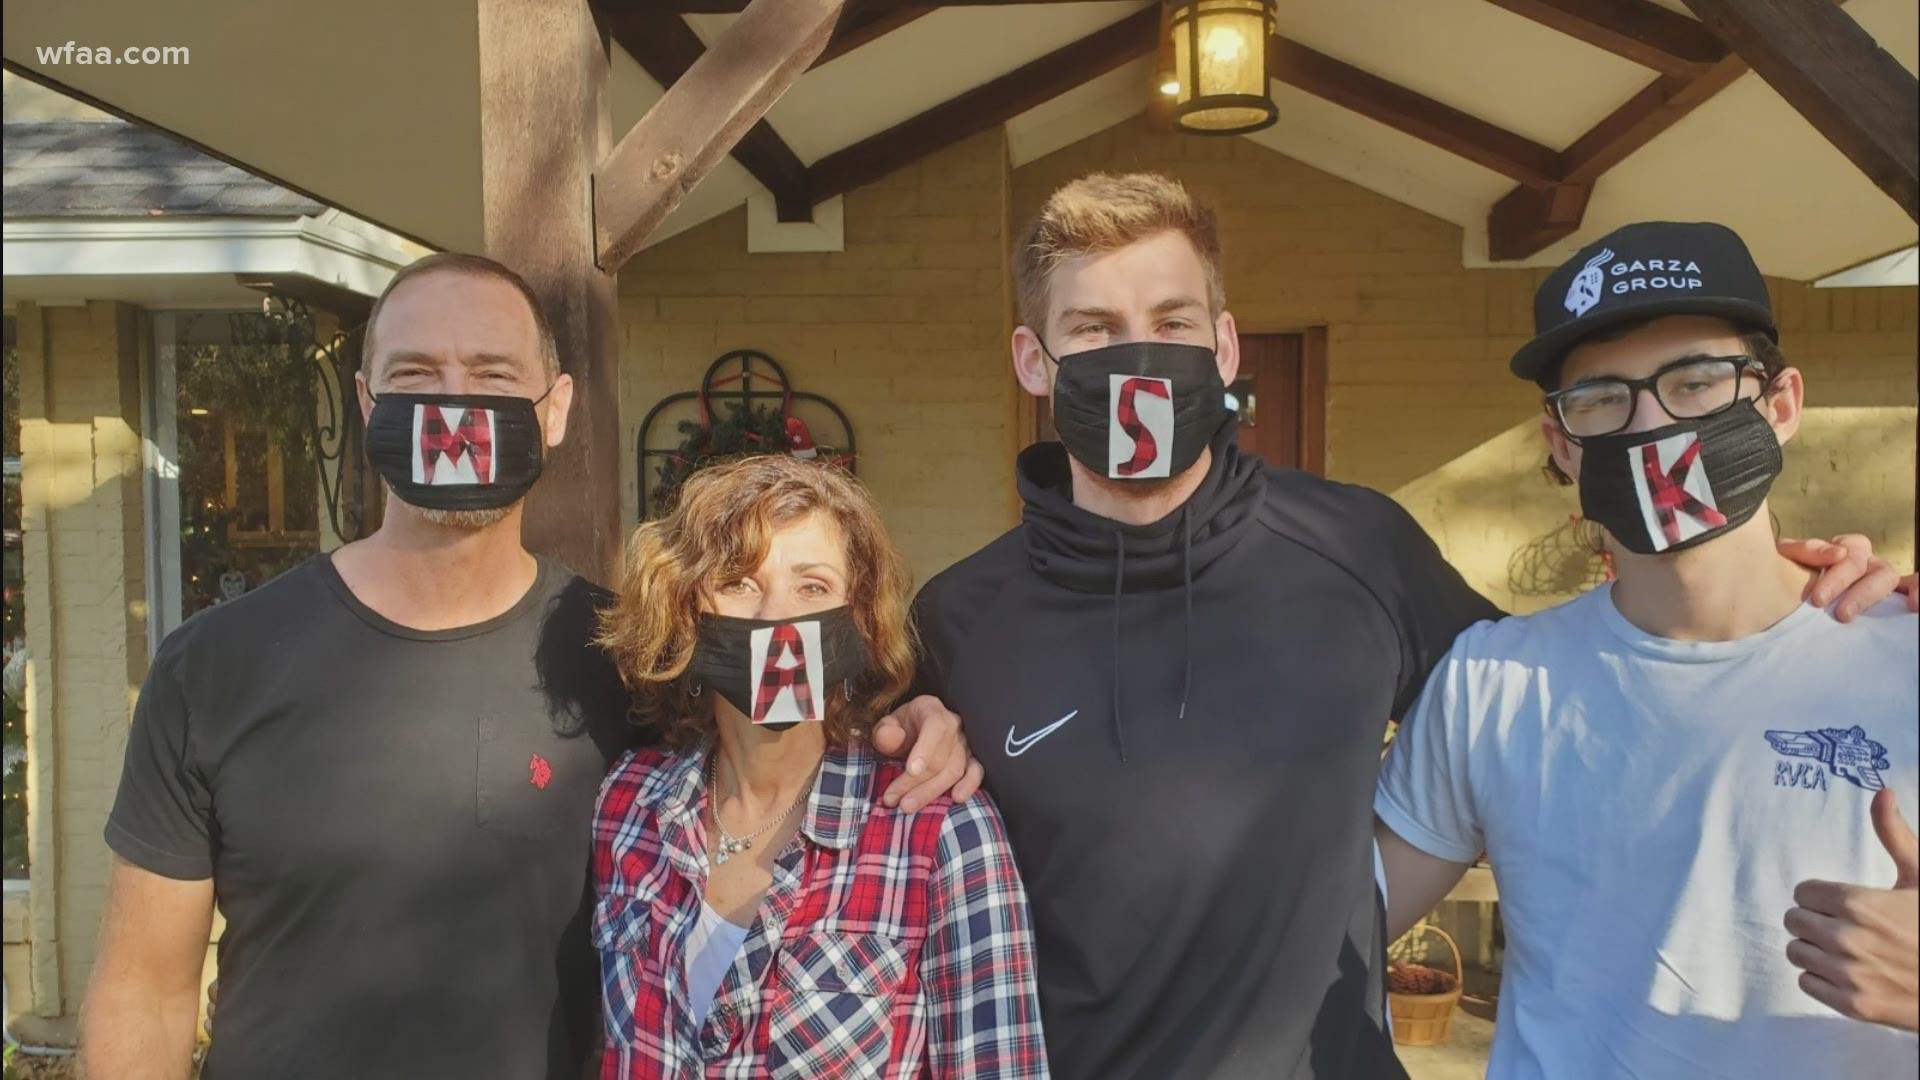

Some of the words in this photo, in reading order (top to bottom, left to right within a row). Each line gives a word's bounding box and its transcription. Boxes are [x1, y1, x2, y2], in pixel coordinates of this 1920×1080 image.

[1611, 260, 1701, 275] GARZA
[1612, 277, 1703, 294] GROUP
[420, 404, 493, 485] M
[1117, 377, 1170, 476] S
[1641, 439, 1728, 546] K
[754, 623, 817, 721] A
[1774, 760, 1827, 791] RVCA
